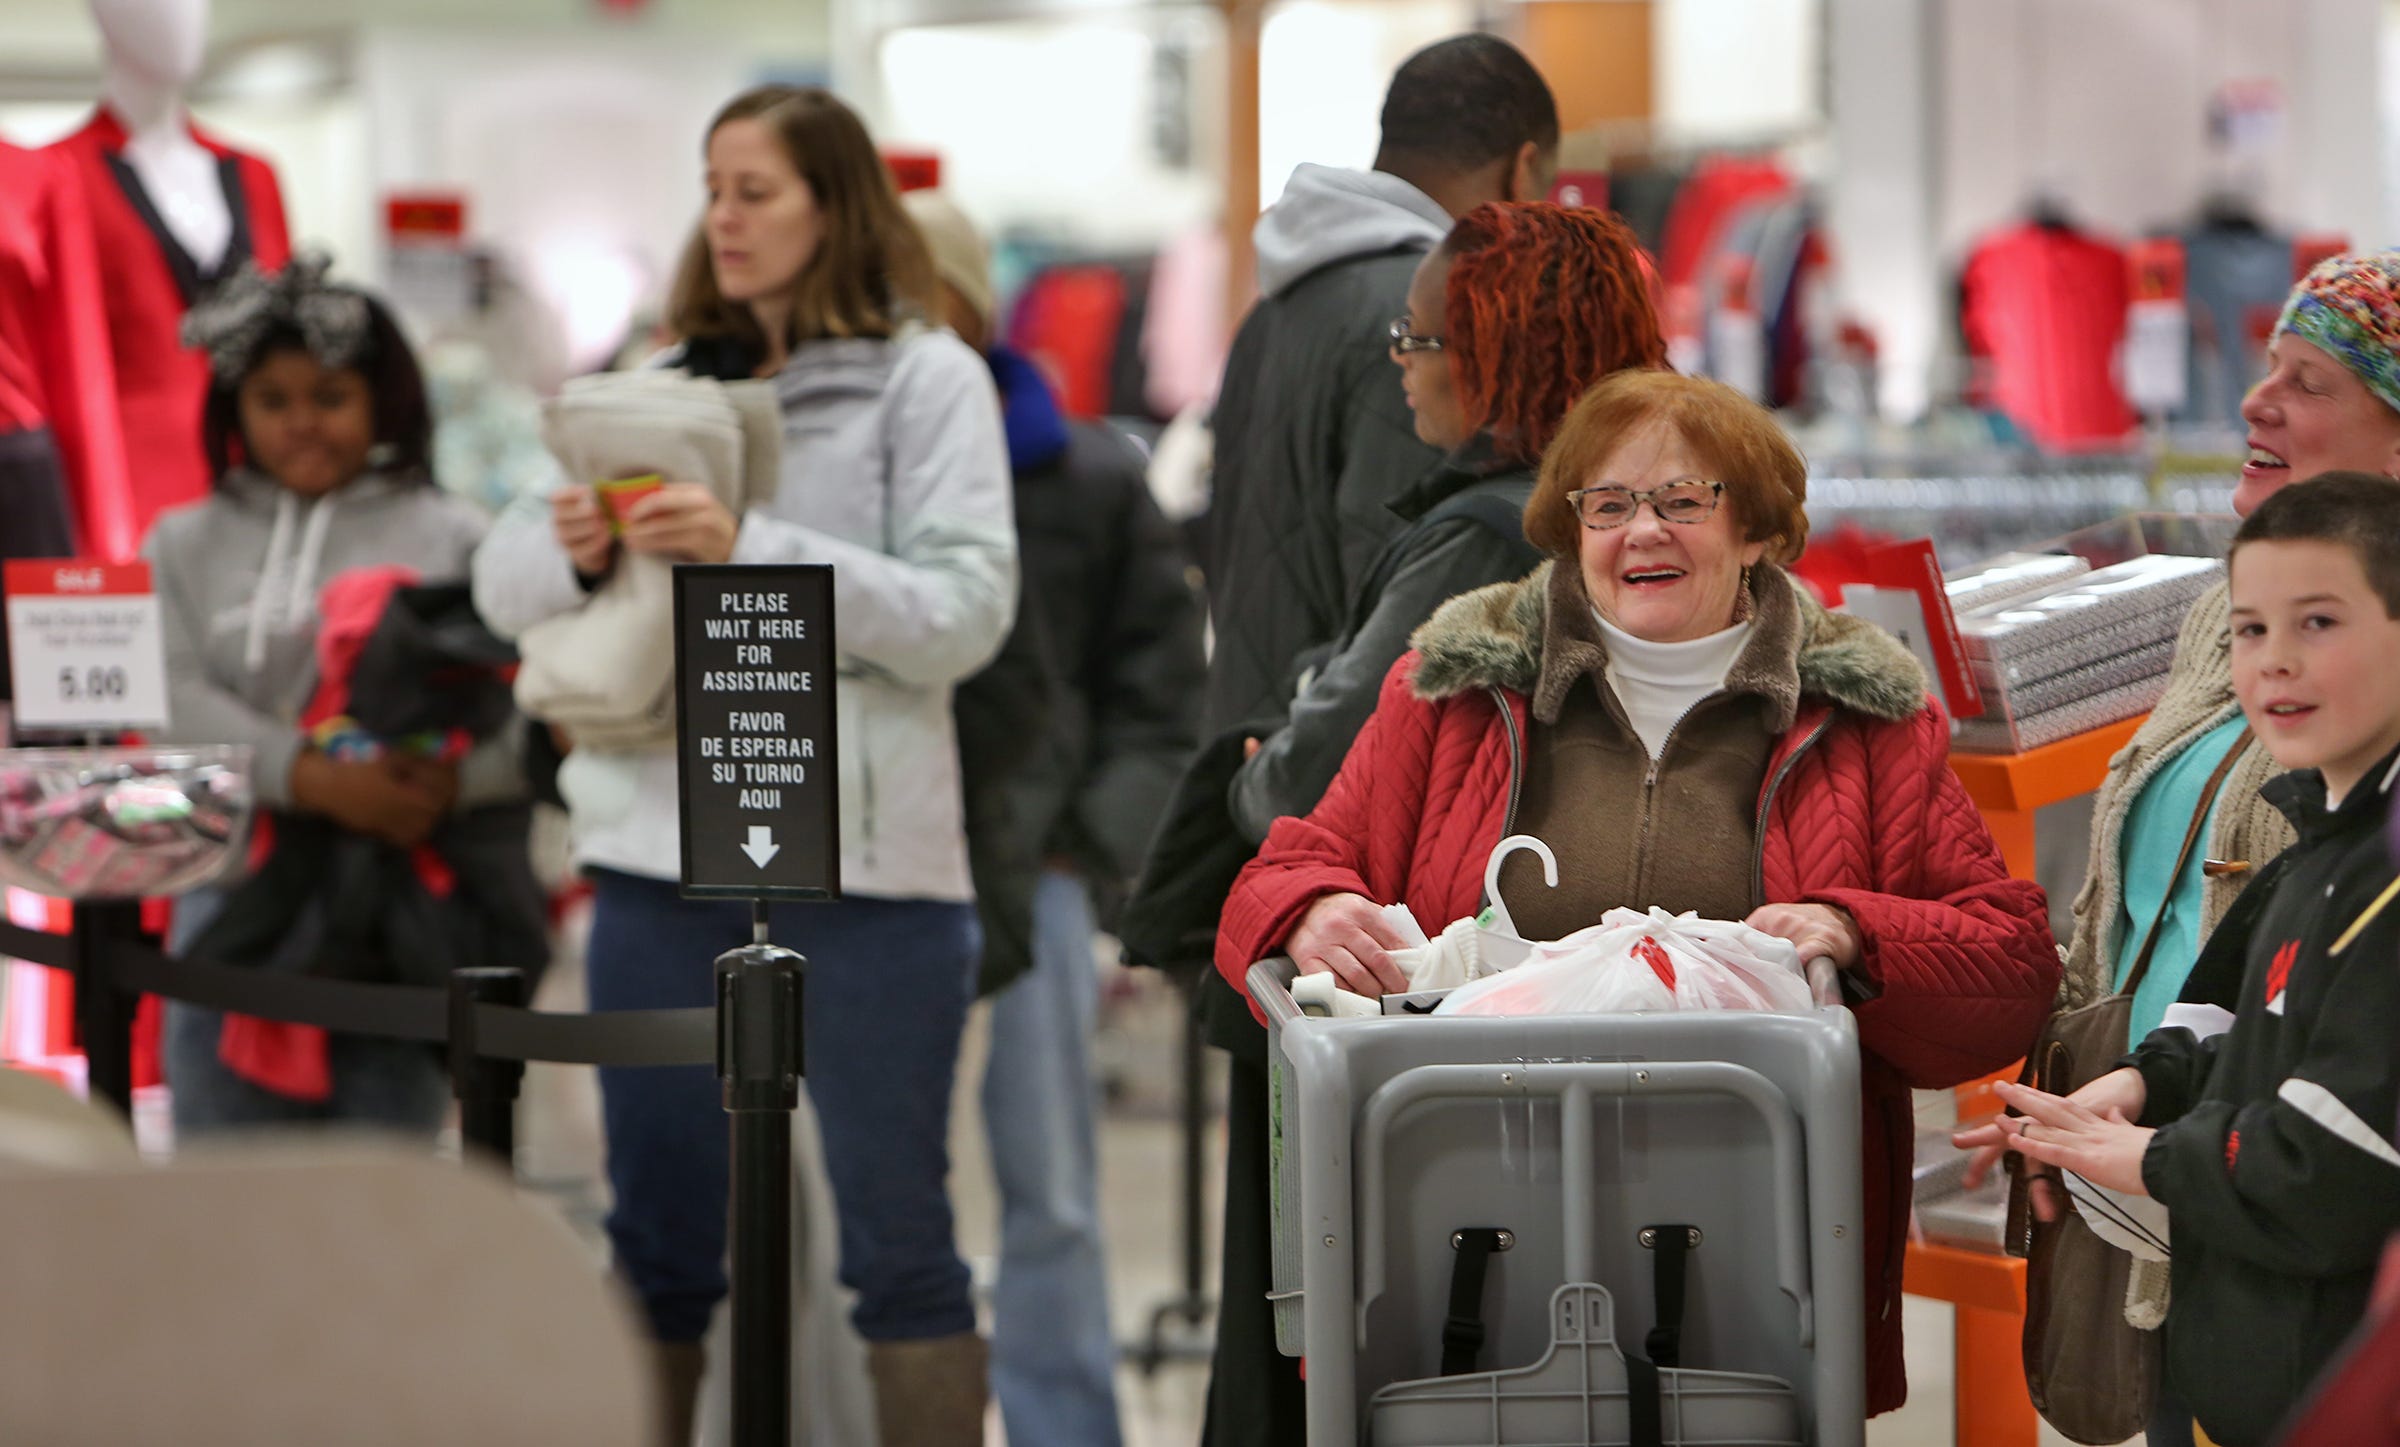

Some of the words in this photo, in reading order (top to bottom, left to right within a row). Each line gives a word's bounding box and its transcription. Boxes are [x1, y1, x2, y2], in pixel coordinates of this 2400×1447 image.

[54, 568, 103, 590] SALE
[721, 593, 789, 612] PLEASE
[705, 619, 751, 639] WAIT
[758, 619, 805, 639] HERE
[737, 645, 772, 664] FOR
[58, 666, 128, 700] 5.00
[703, 671, 812, 691] ASSISTANCE
[729, 712, 786, 732] FAVOR
[701, 737, 724, 757] DE
[731, 738, 814, 758] ESPERAR
[712, 763, 736, 783] SU
[743, 763, 805, 784] TURNO
[739, 789, 781, 809] AQUI
